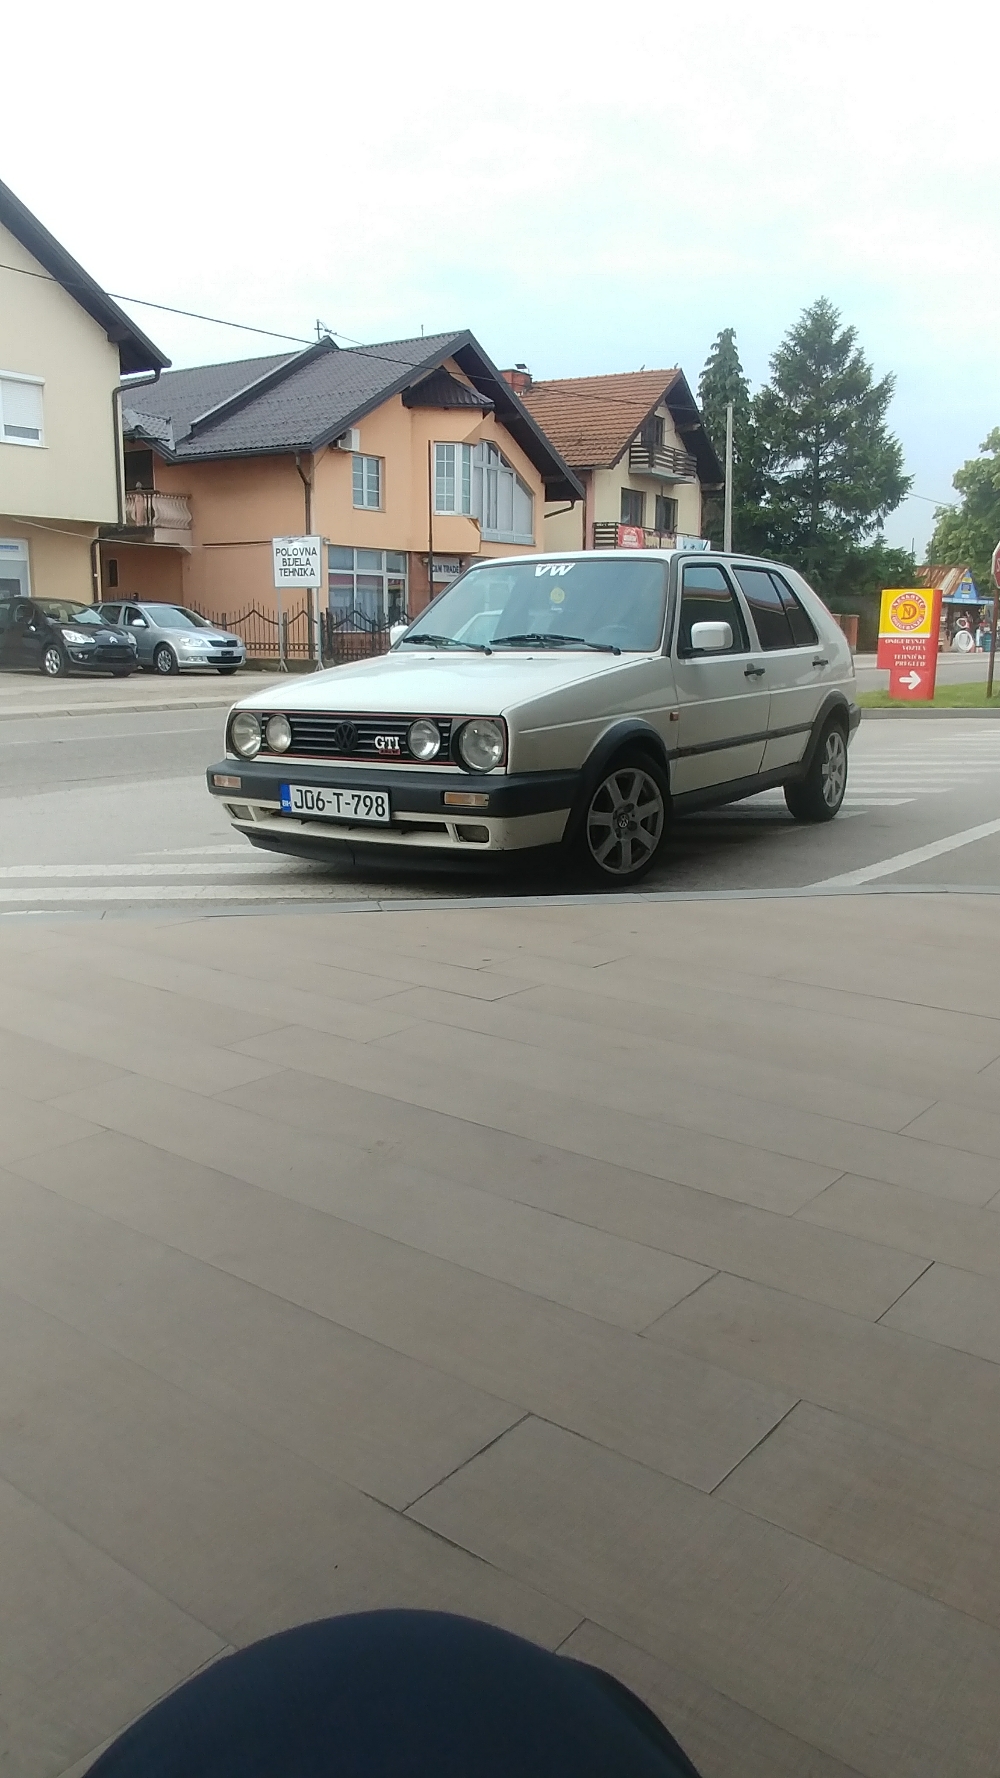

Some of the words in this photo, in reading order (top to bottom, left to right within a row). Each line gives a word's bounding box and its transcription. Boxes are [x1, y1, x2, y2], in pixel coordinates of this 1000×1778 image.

[275, 547, 317, 557] POLOVNA
[282, 557, 311, 567] BIJELA
[279, 567, 316, 577] TEHNIKA
[443, 564, 459, 574] TRADE
[534, 562, 576, 577] VW
[374, 735, 400, 750] GTI
